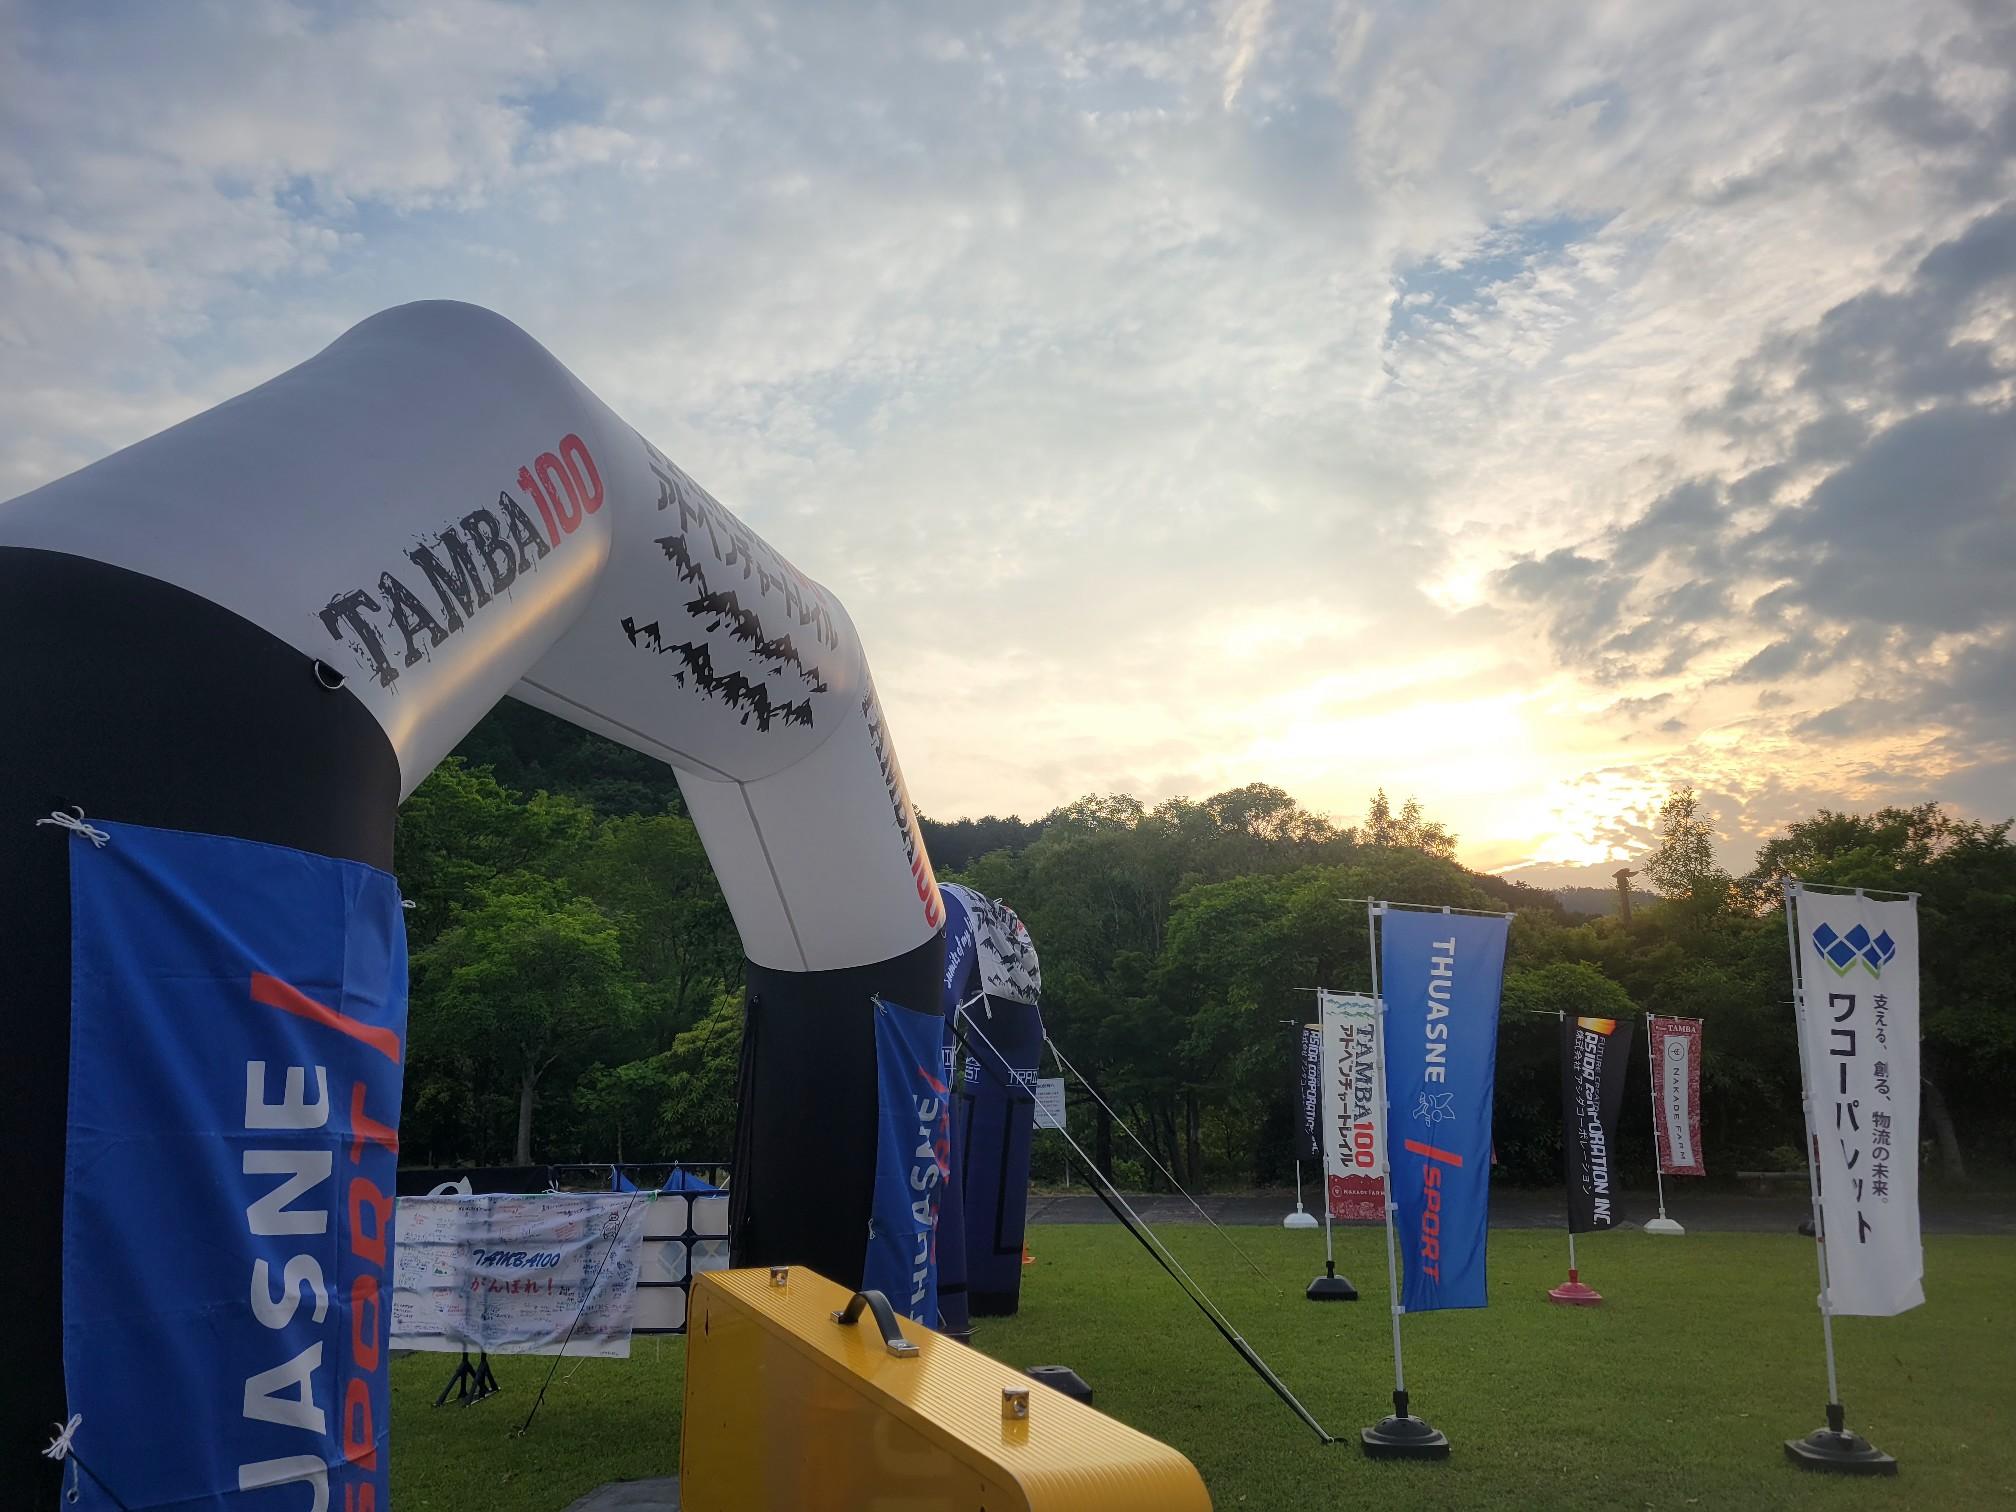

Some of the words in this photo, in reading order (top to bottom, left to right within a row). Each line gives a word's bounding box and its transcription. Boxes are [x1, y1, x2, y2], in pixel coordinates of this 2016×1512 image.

[318, 432, 605, 690] TAMBA100
[1424, 937, 1456, 1084] THUASNE
[1667, 1024, 1697, 1033] TAMBA
[1337, 1025, 1354, 1168] アドベンチャートレイル
[1354, 1023, 1375, 1168] TAMBA100
[1672, 1067, 1681, 1120] NAKADE
[1828, 992, 1872, 1244] ワコーパレット
[472, 1249, 561, 1267] TAMBA100
[1420, 1165, 1442, 1286] SPORT
[1592, 1198, 1611, 1226] INC.
